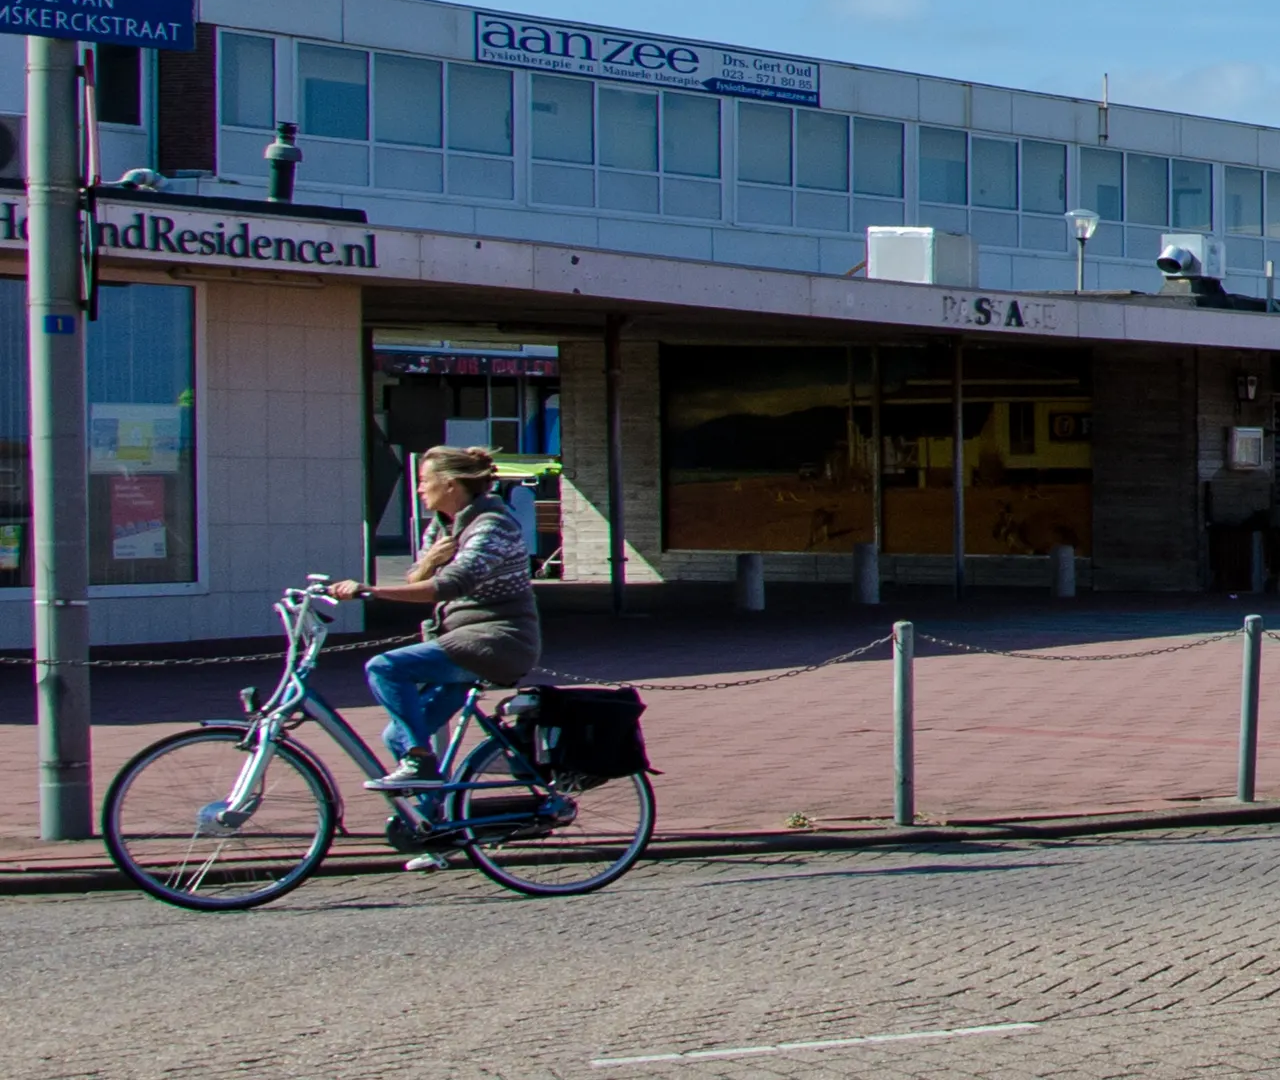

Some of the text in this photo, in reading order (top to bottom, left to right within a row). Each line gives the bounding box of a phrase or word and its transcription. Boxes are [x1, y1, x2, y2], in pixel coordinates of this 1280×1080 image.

[482, 21, 699, 74] aanzee
[722, 54, 812, 78] Drs. Gert Oud
[482, 48, 701, 87] Fysiotherapie en Manuele therapie
[722, 68, 744, 80] 023
[756, 73, 777, 85] 571
[781, 77, 796, 87] 80
[0, 203, 380, 268] HndResidence.nl
